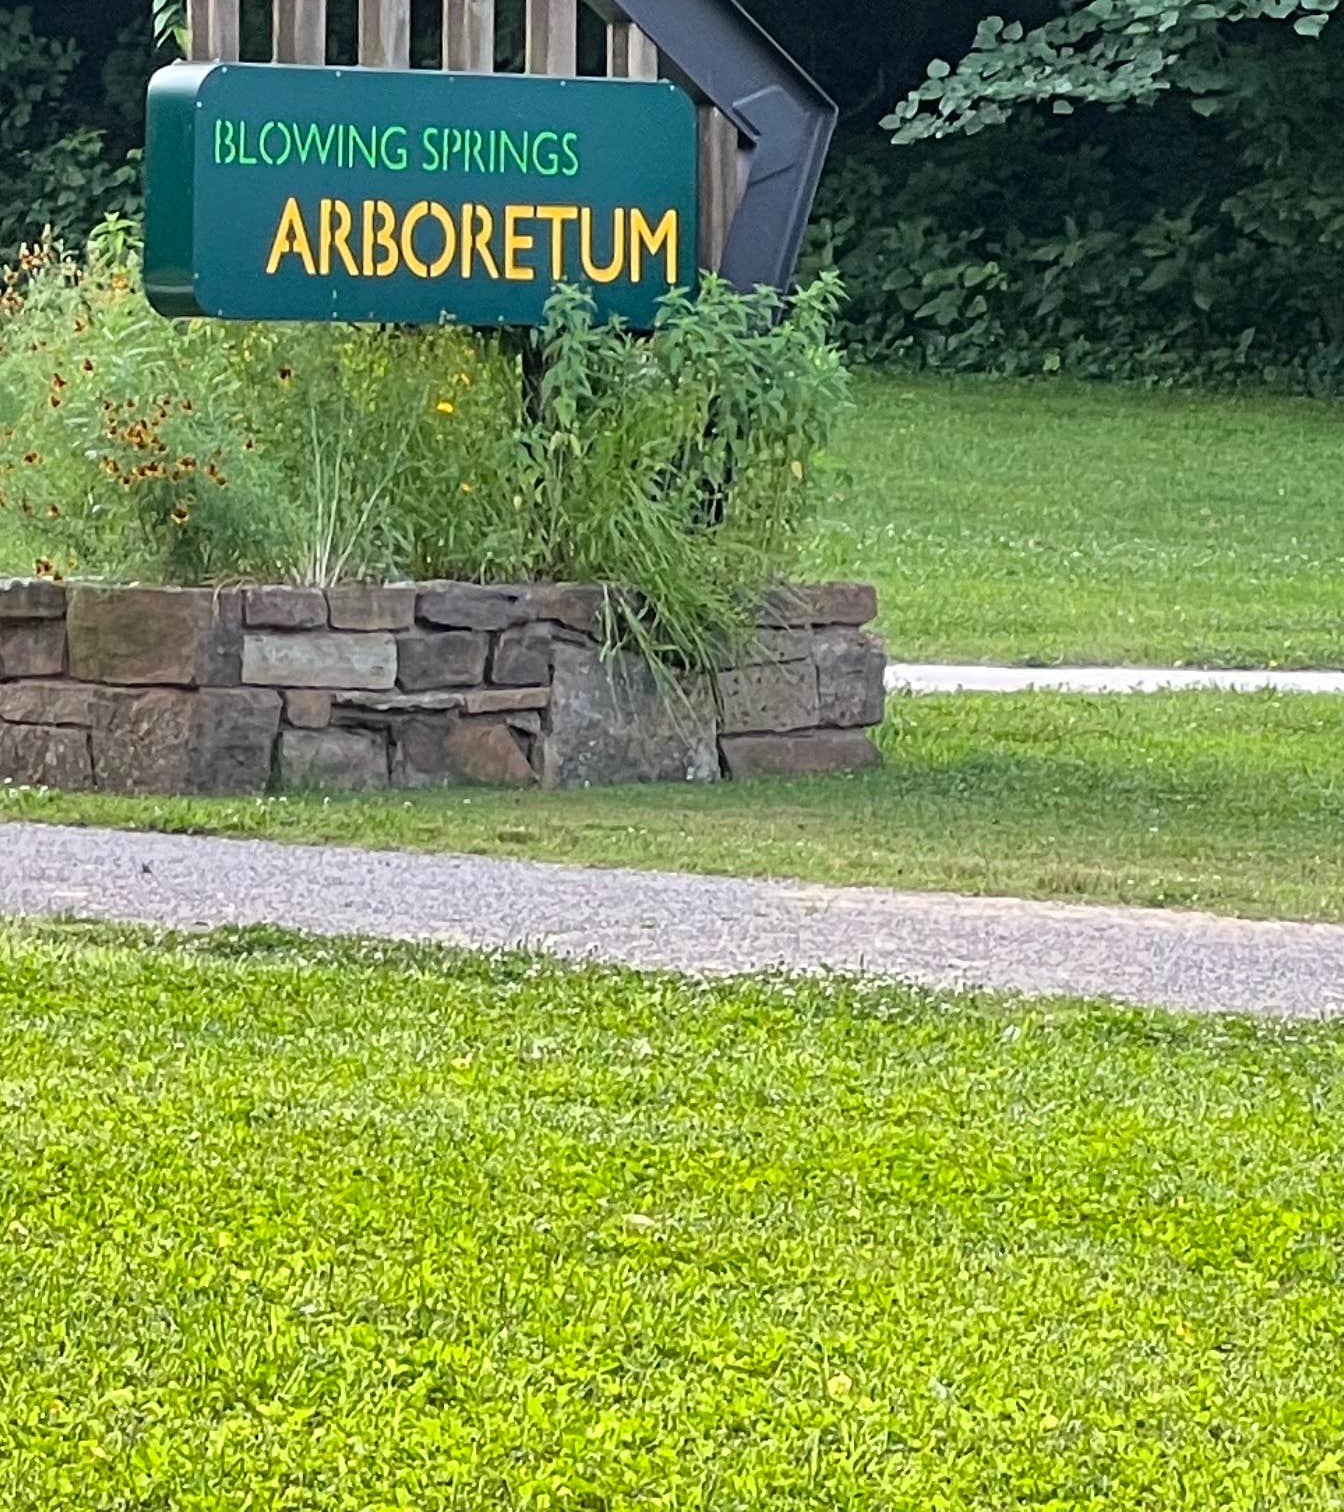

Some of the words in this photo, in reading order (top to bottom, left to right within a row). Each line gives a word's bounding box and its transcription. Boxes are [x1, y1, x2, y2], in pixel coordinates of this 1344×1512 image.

[213, 119, 408, 171] BLOWING
[422, 126, 580, 177] SPRINGS
[265, 196, 679, 285] ARBORETUM
